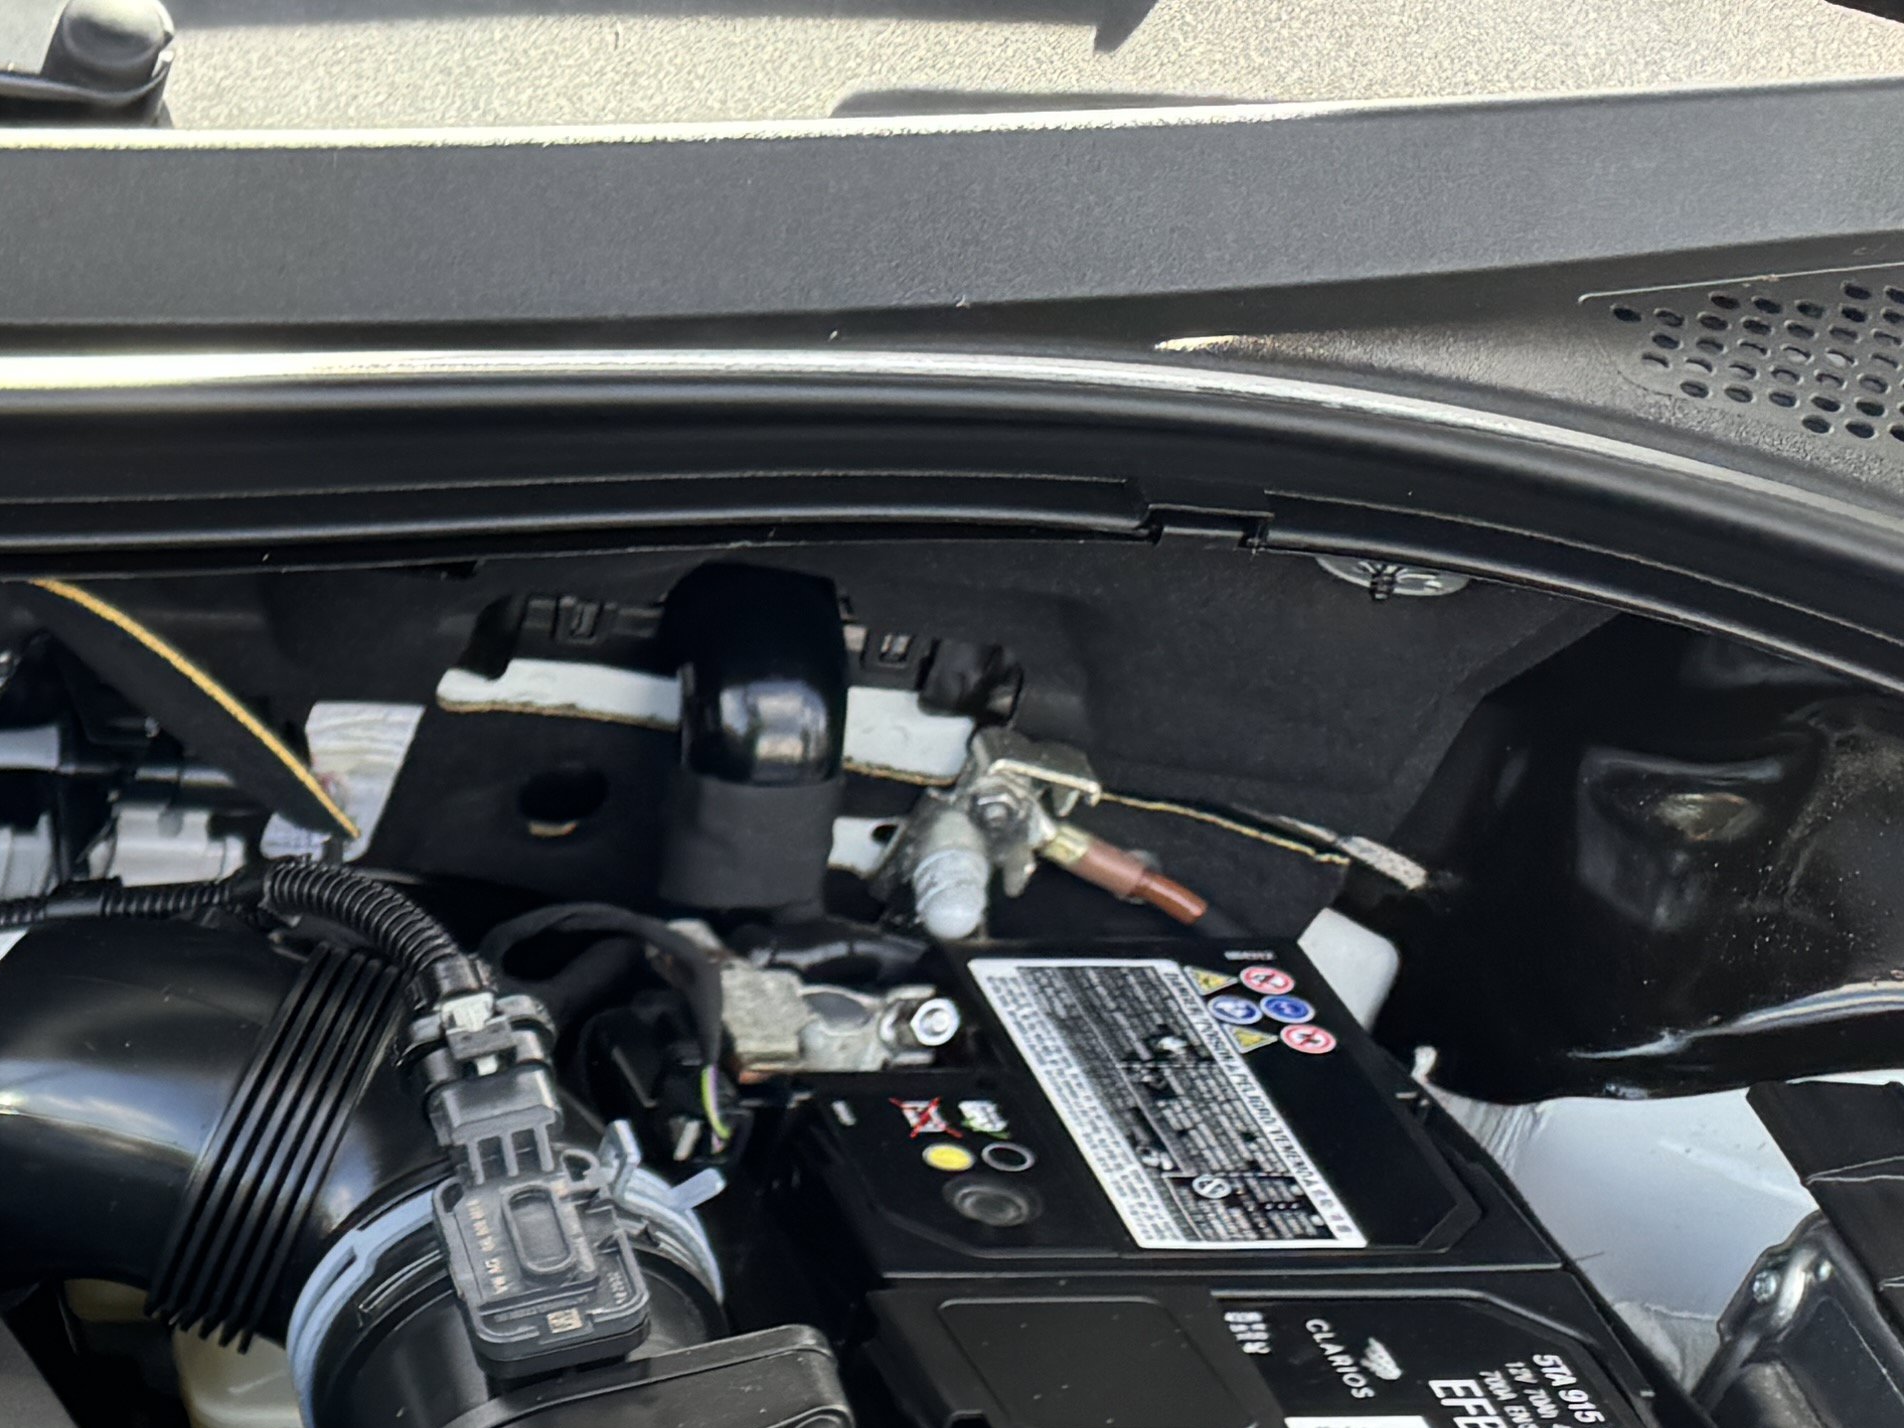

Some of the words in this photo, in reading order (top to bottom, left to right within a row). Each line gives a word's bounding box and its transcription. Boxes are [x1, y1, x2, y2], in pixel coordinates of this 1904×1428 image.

[1304, 1317, 1375, 1401] CLARIOS
[1532, 1354, 1577, 1387] 5TA
[1558, 1389, 1606, 1424] 915
